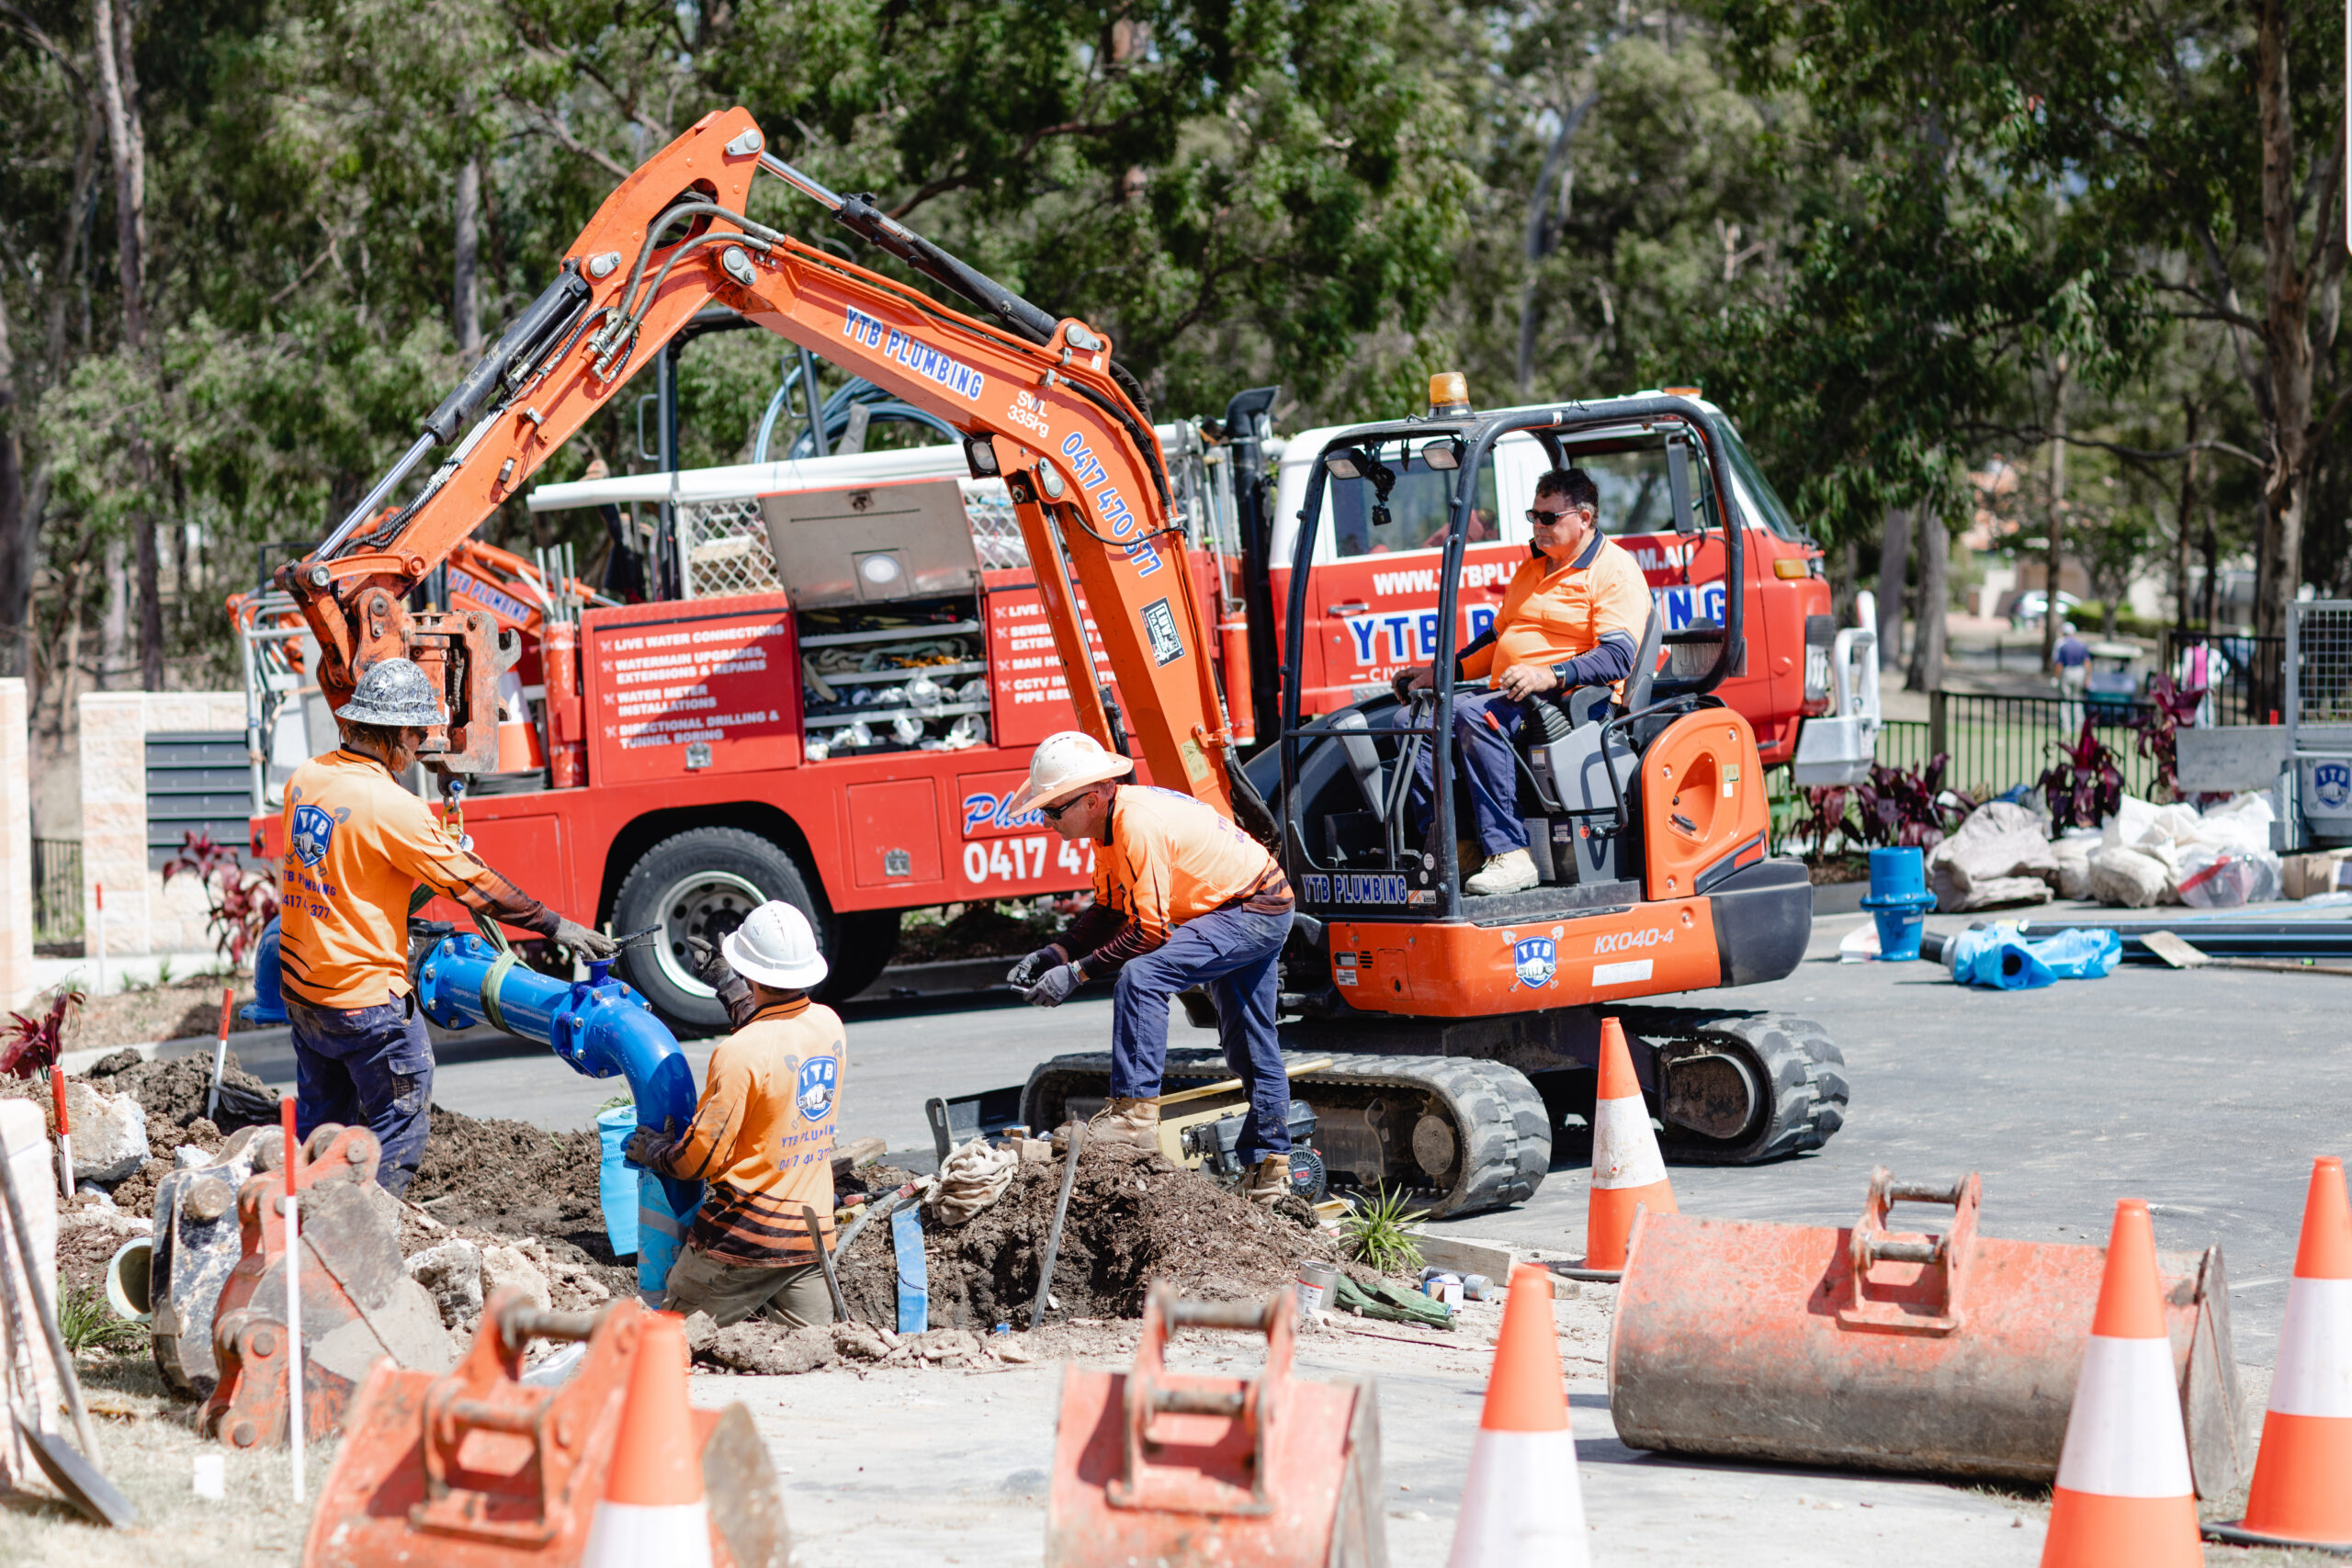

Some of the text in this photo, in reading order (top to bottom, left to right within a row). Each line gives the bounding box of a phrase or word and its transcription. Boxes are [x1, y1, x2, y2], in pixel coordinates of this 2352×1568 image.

[843, 305, 984, 401] YTB PLUMBING
[1016, 390, 1048, 418] SWL
[1007, 404, 1049, 438] 335kg
[1061, 432, 1162, 578] 0417 470 377
[448, 567, 531, 624] YTB PLUMBING
[1009, 604, 1038, 617] LIVE
[1155, 607, 1173, 637] LUV
[614, 624, 785, 651] LIVE WATER CONNECTIONS
[1343, 608, 1439, 667] YTB
[615, 646, 767, 671] WATERMAIN UPGRADES,
[1012, 657, 1043, 671] MAN
[616, 659, 767, 685] EXTENSIONS & REPAIRS
[1013, 677, 1049, 691] CCTV
[617, 684, 708, 705] WATER METER
[618, 696, 717, 717] INSTALLATIONS
[1014, 691, 1045, 705] PIPE
[619, 710, 780, 737] DIRECTIONAL DRILLING &
[619, 728, 724, 750] TUNNEL BORING
[963, 837, 1095, 884] 0417 47
[281, 893, 301, 908] 417
[1301, 874, 1408, 905] YTB PLUMBING
[310, 904, 330, 919] 377
[1518, 942, 1552, 959] YTB
[1593, 928, 1674, 955] KX040-4
[801, 1063, 834, 1087] YTB
